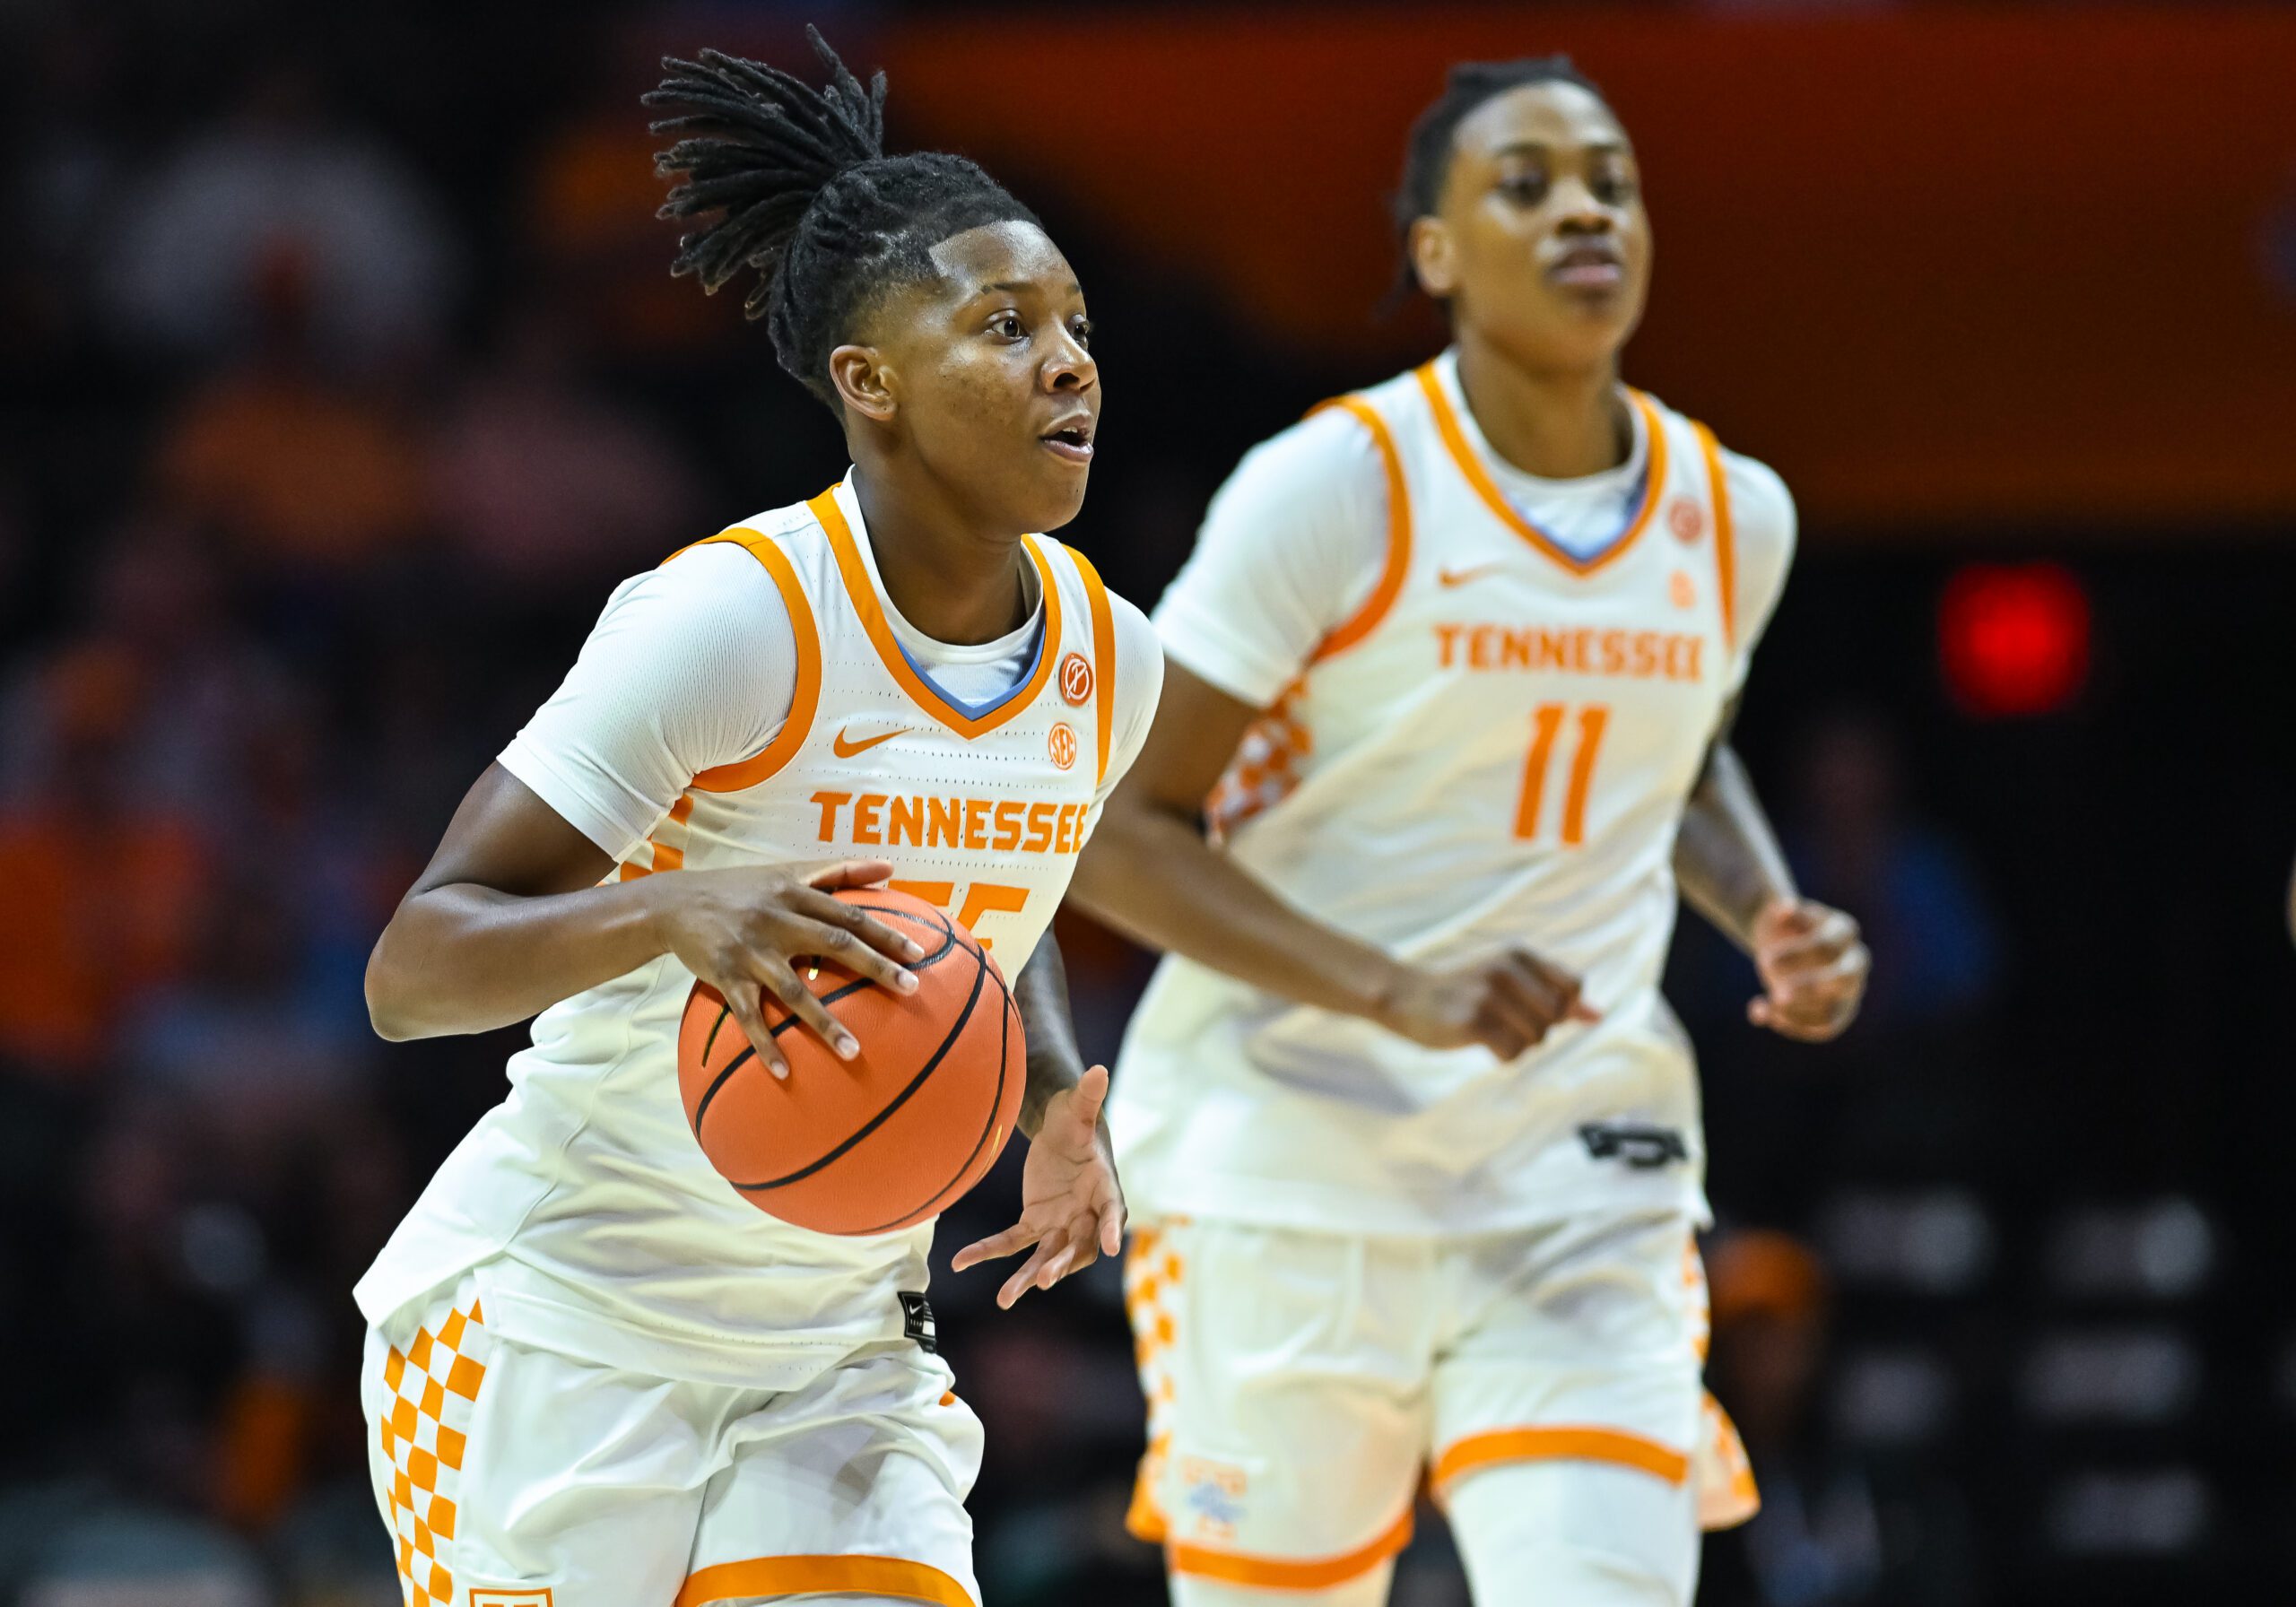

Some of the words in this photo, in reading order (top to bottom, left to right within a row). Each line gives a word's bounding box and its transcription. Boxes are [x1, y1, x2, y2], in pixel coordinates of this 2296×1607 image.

[1435, 625, 1703, 682] TENNESSEE
[1049, 725, 1075, 767] SEC
[1513, 704, 1610, 845] 11
[810, 791, 1089, 854] TENNESSEE
